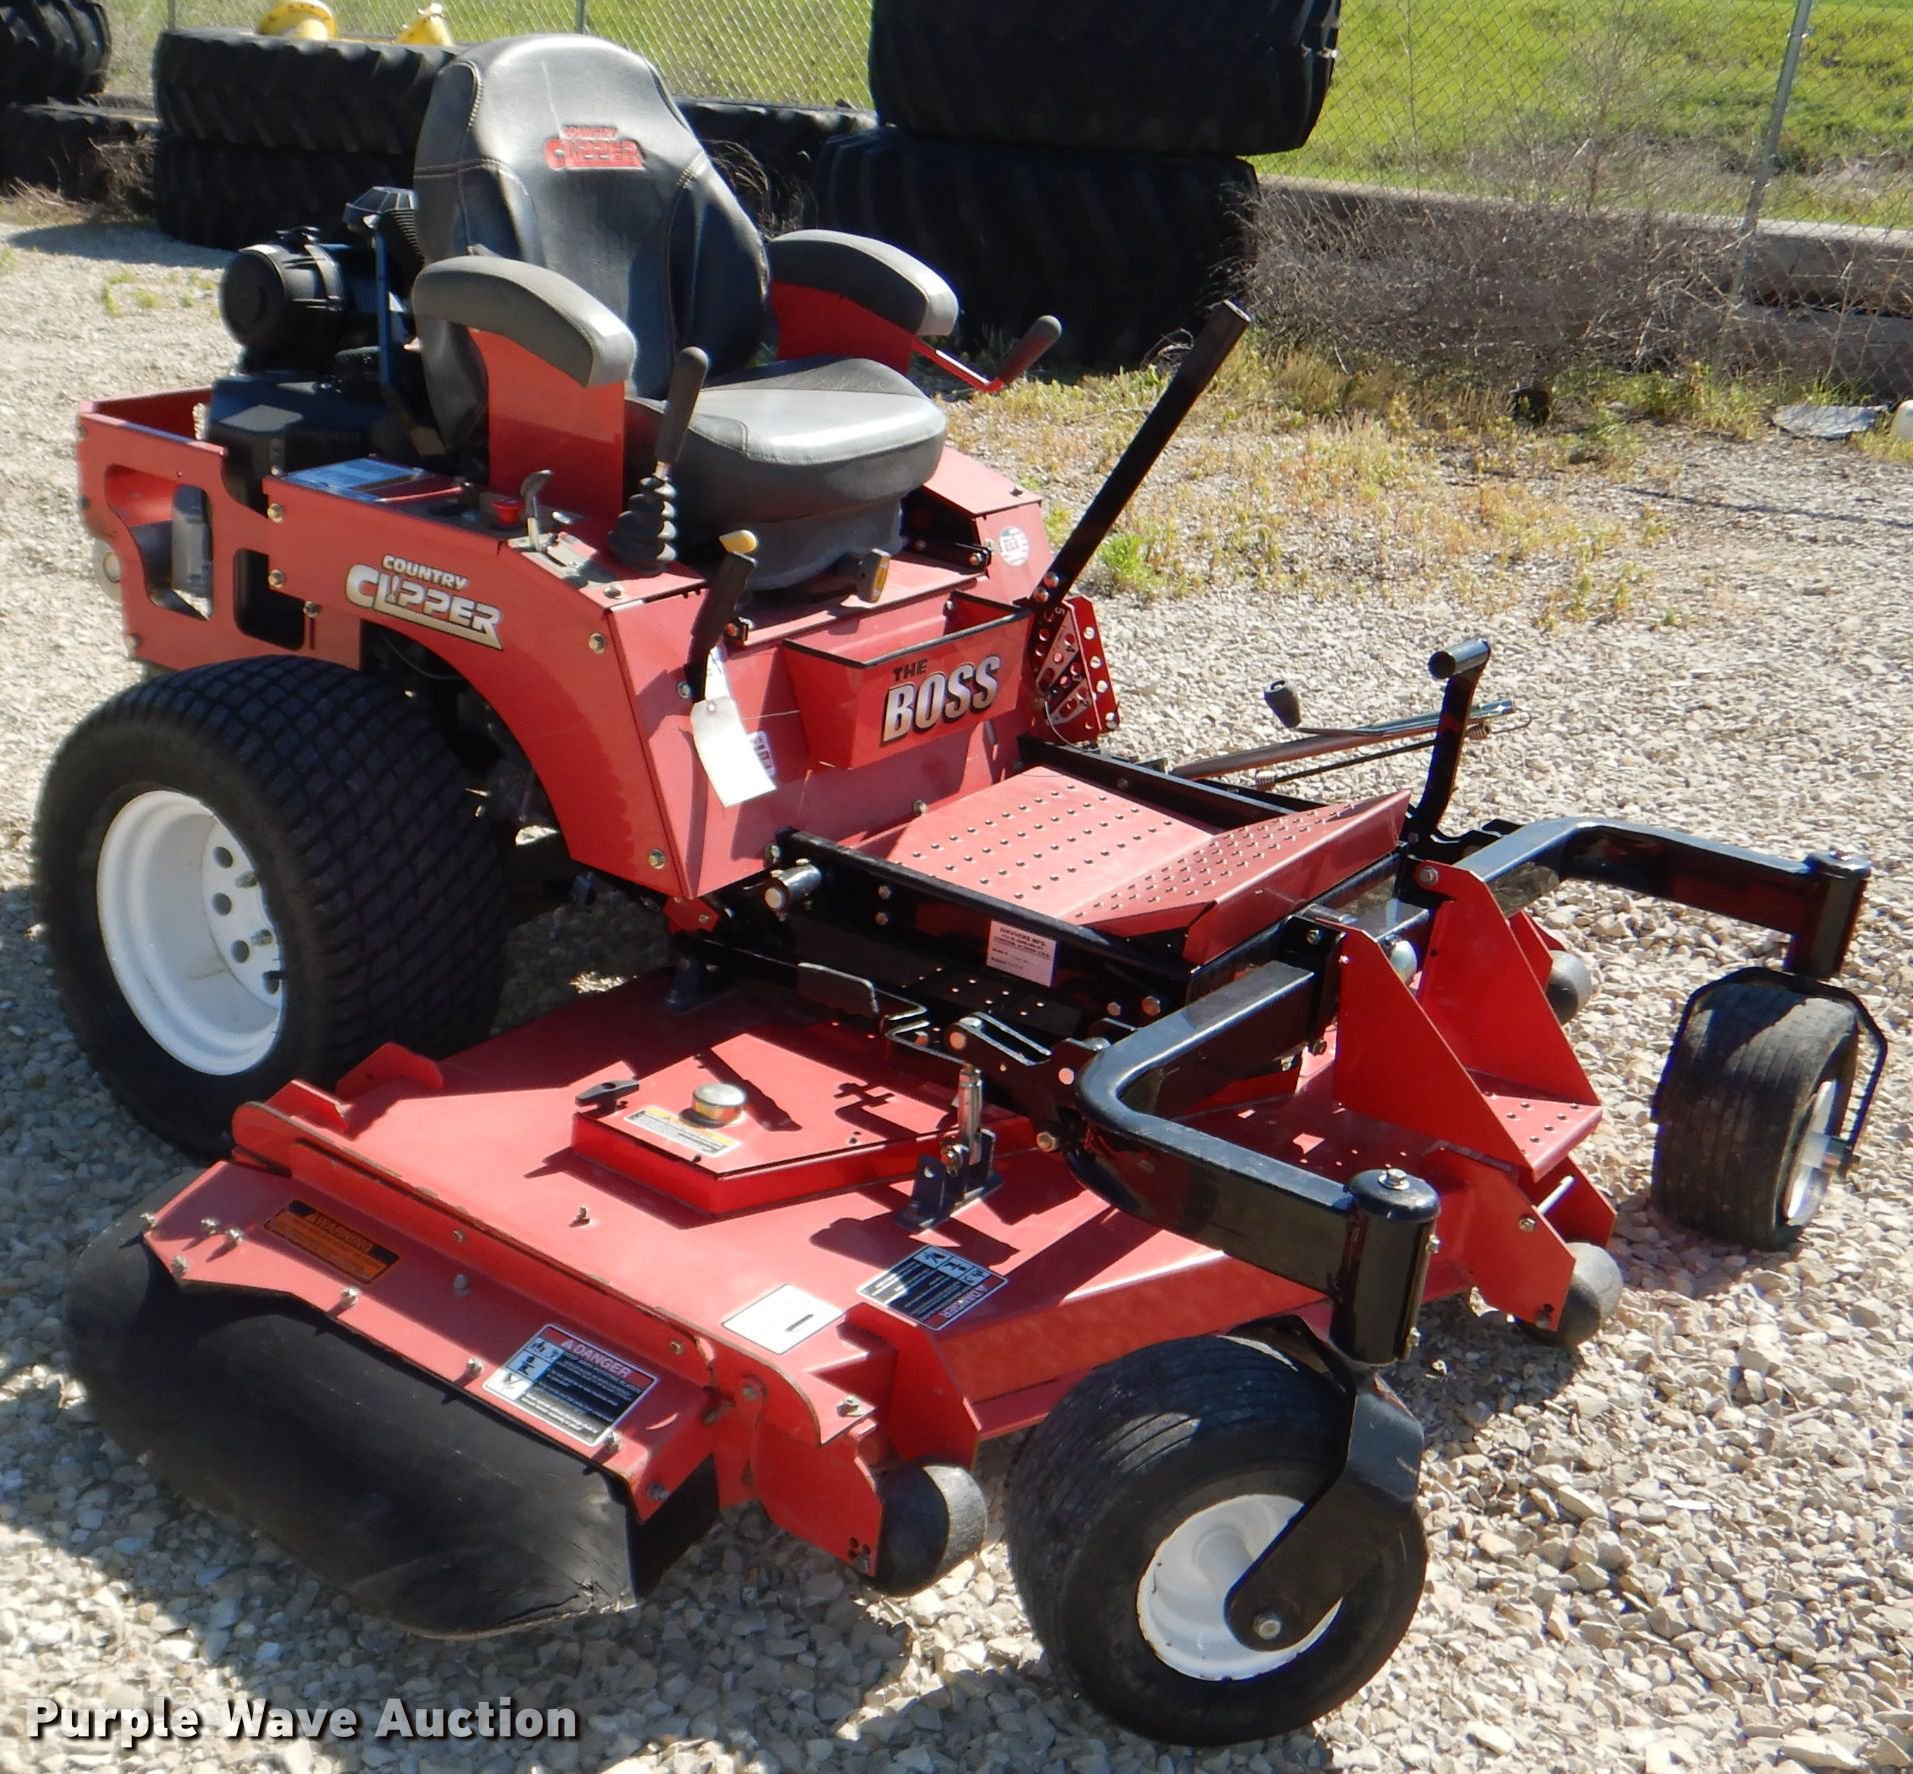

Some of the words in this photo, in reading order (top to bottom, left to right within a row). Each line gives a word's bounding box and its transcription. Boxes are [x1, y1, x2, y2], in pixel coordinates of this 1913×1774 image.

[382, 554, 468, 591] COUNTRY
[345, 563, 504, 651] CLIPPER
[893, 659, 929, 682] THE
[880, 655, 1001, 747] BOSS
[939, 1288, 982, 1319] DANGER
[573, 1341, 633, 1378] DANGER
